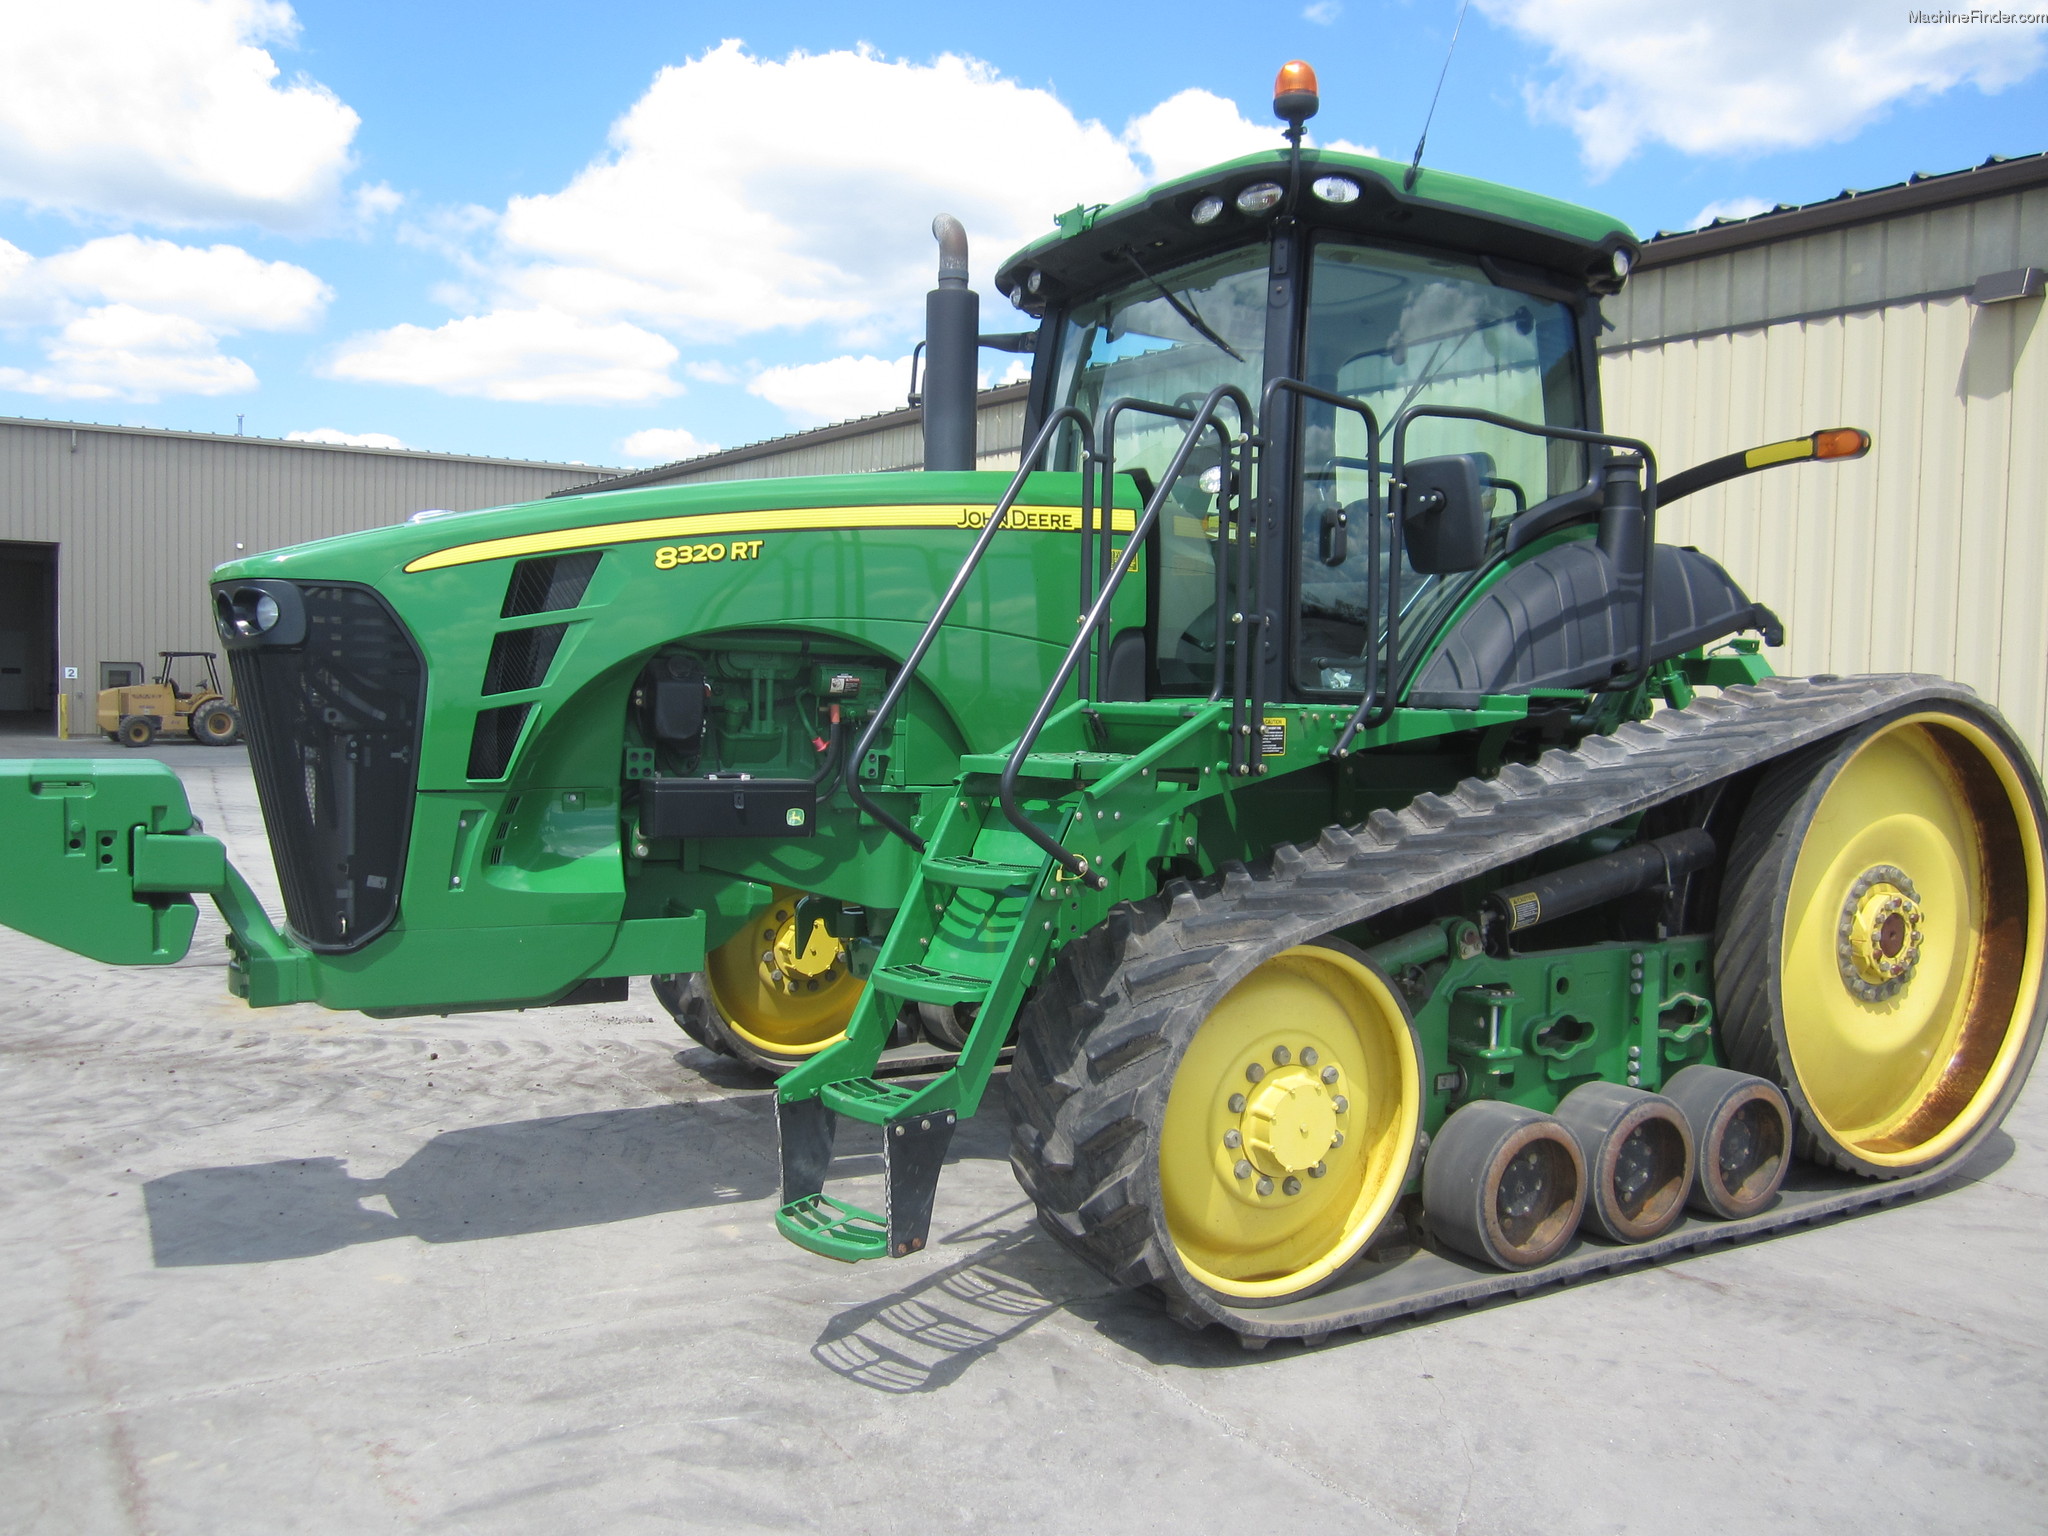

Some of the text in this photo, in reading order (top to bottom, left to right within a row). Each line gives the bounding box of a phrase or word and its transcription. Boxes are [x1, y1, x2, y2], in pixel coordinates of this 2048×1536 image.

[1012, 510, 1073, 528] DEERE
[654, 540, 764, 570] 8320 RT
[68, 668, 75, 678] 2
